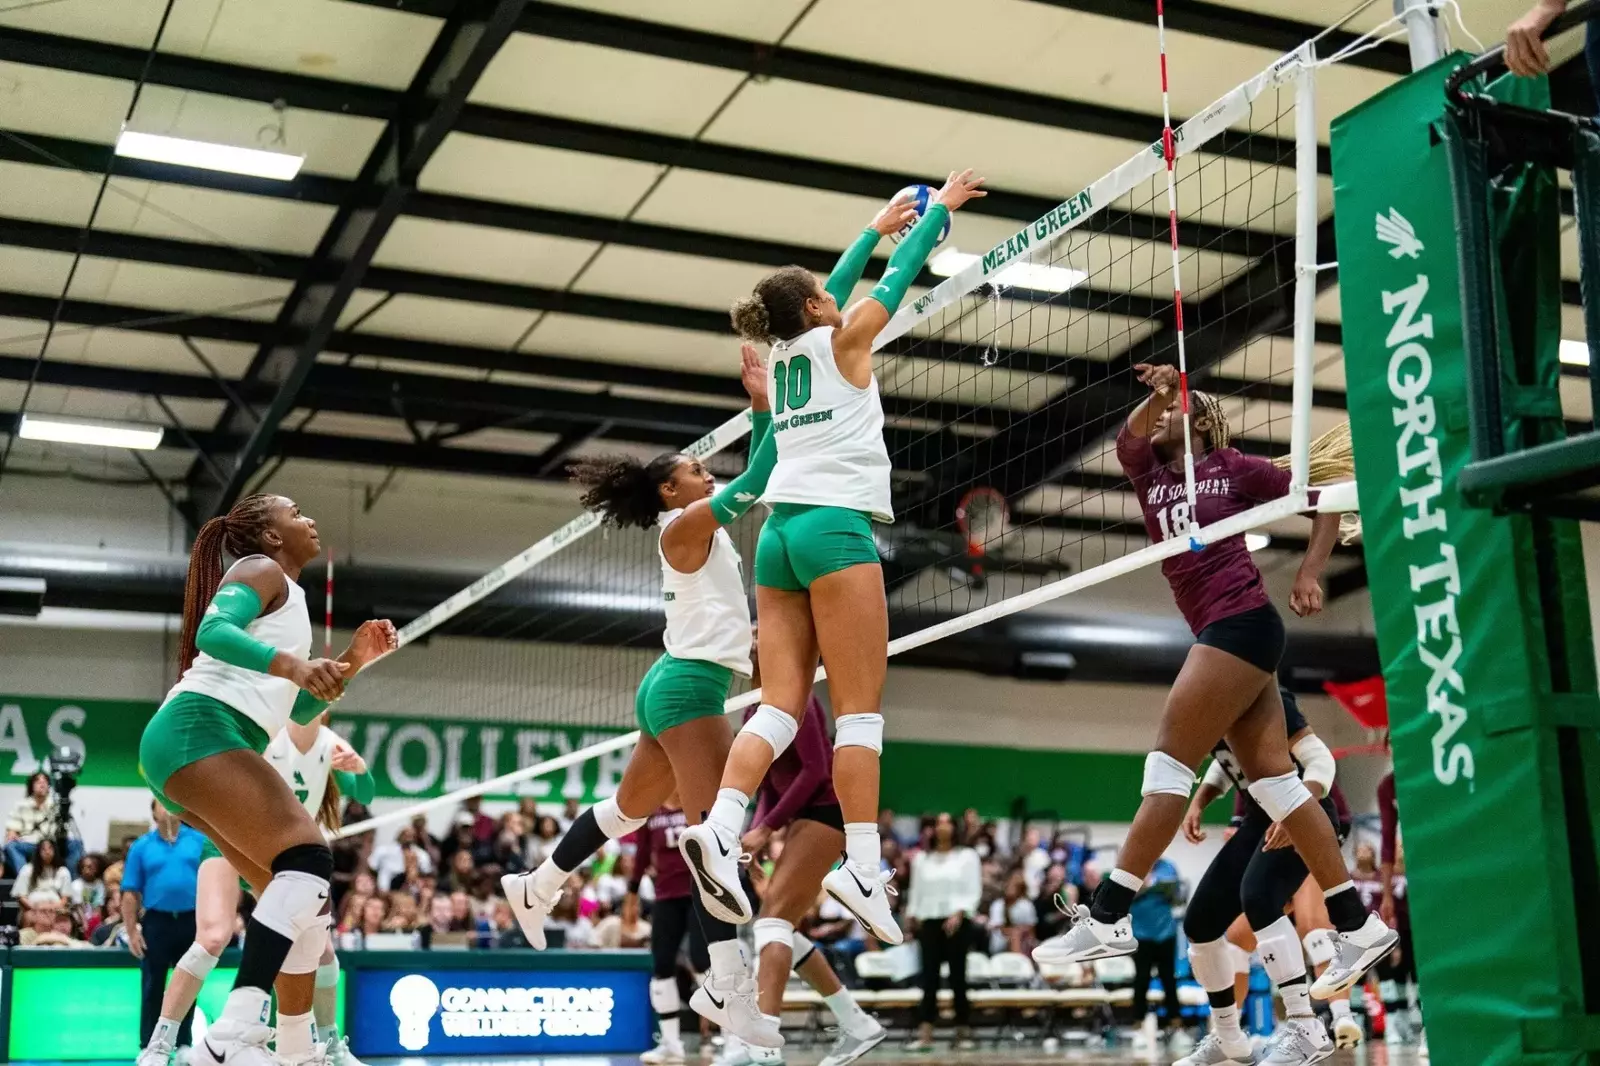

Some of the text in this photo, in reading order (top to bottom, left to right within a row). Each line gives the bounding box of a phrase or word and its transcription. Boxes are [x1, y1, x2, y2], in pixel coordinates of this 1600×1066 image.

[982, 187, 1093, 275] MEAN GREEN
[774, 354, 812, 416] 10
[790, 409, 834, 429] GREEN
[1156, 501, 1190, 541] 18
[1381, 273, 1475, 785] NORTH TEXAS
